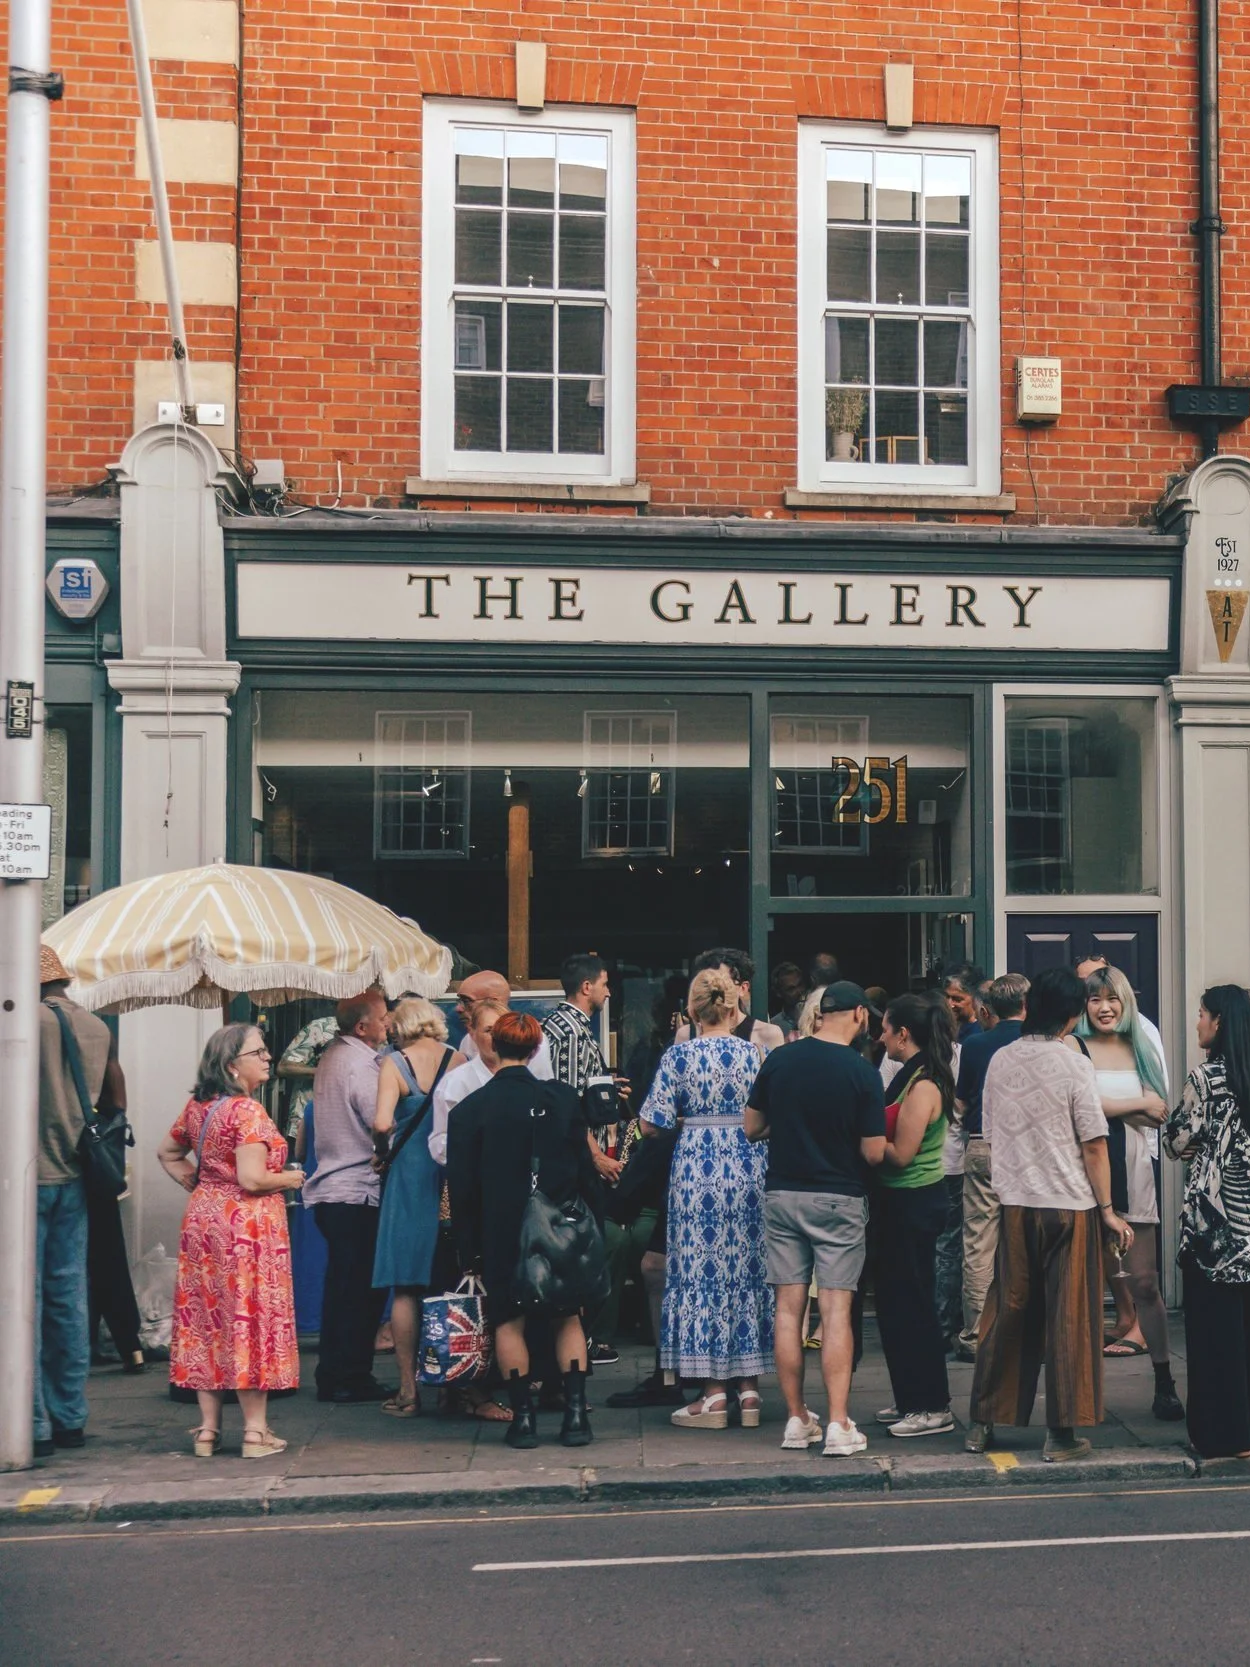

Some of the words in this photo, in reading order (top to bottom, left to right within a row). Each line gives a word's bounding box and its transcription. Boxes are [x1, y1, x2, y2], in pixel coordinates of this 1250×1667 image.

[1025, 367, 1059, 377] CERTES
[1217, 558, 1239, 571] 1927
[407, 573, 585, 621] THE
[649, 579, 1043, 629] GALLERY
[832, 755, 907, 823] 251
[0, 810, 32, 820] ading
[10, 820, 25, 829] Fri
[3, 831, 33, 840] 10am
[0, 842, 41, 852] .30pm
[2, 864, 33, 874] 10am
